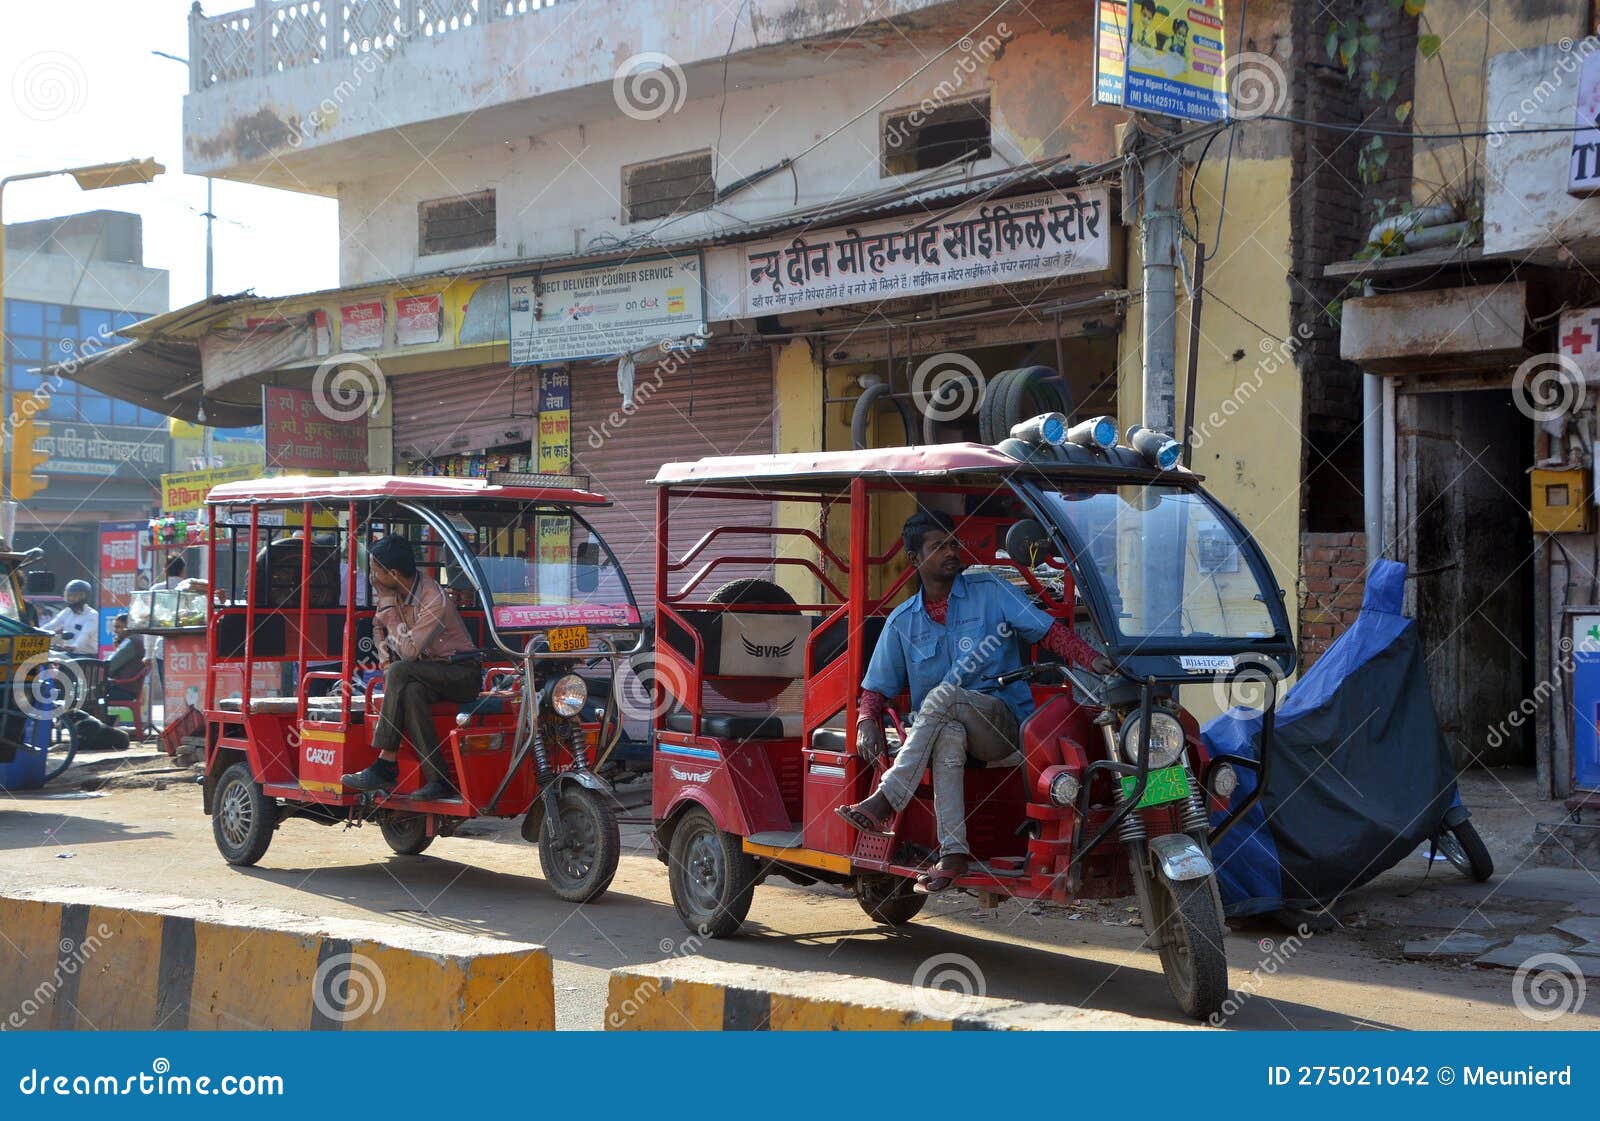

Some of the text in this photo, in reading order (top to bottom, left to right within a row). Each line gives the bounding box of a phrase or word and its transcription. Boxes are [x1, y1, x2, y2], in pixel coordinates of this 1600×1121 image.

[748, 191, 1102, 294] न्यू दीन मोहम्मद साईकिल स्टोर
[563, 275, 599, 291] DELIVERY
[602, 271, 637, 286] COURIER
[639, 266, 674, 282] SERVICE
[563, 638, 586, 650] 9500
[756, 645, 781, 658] BVR
[681, 772, 701, 782] BVR
